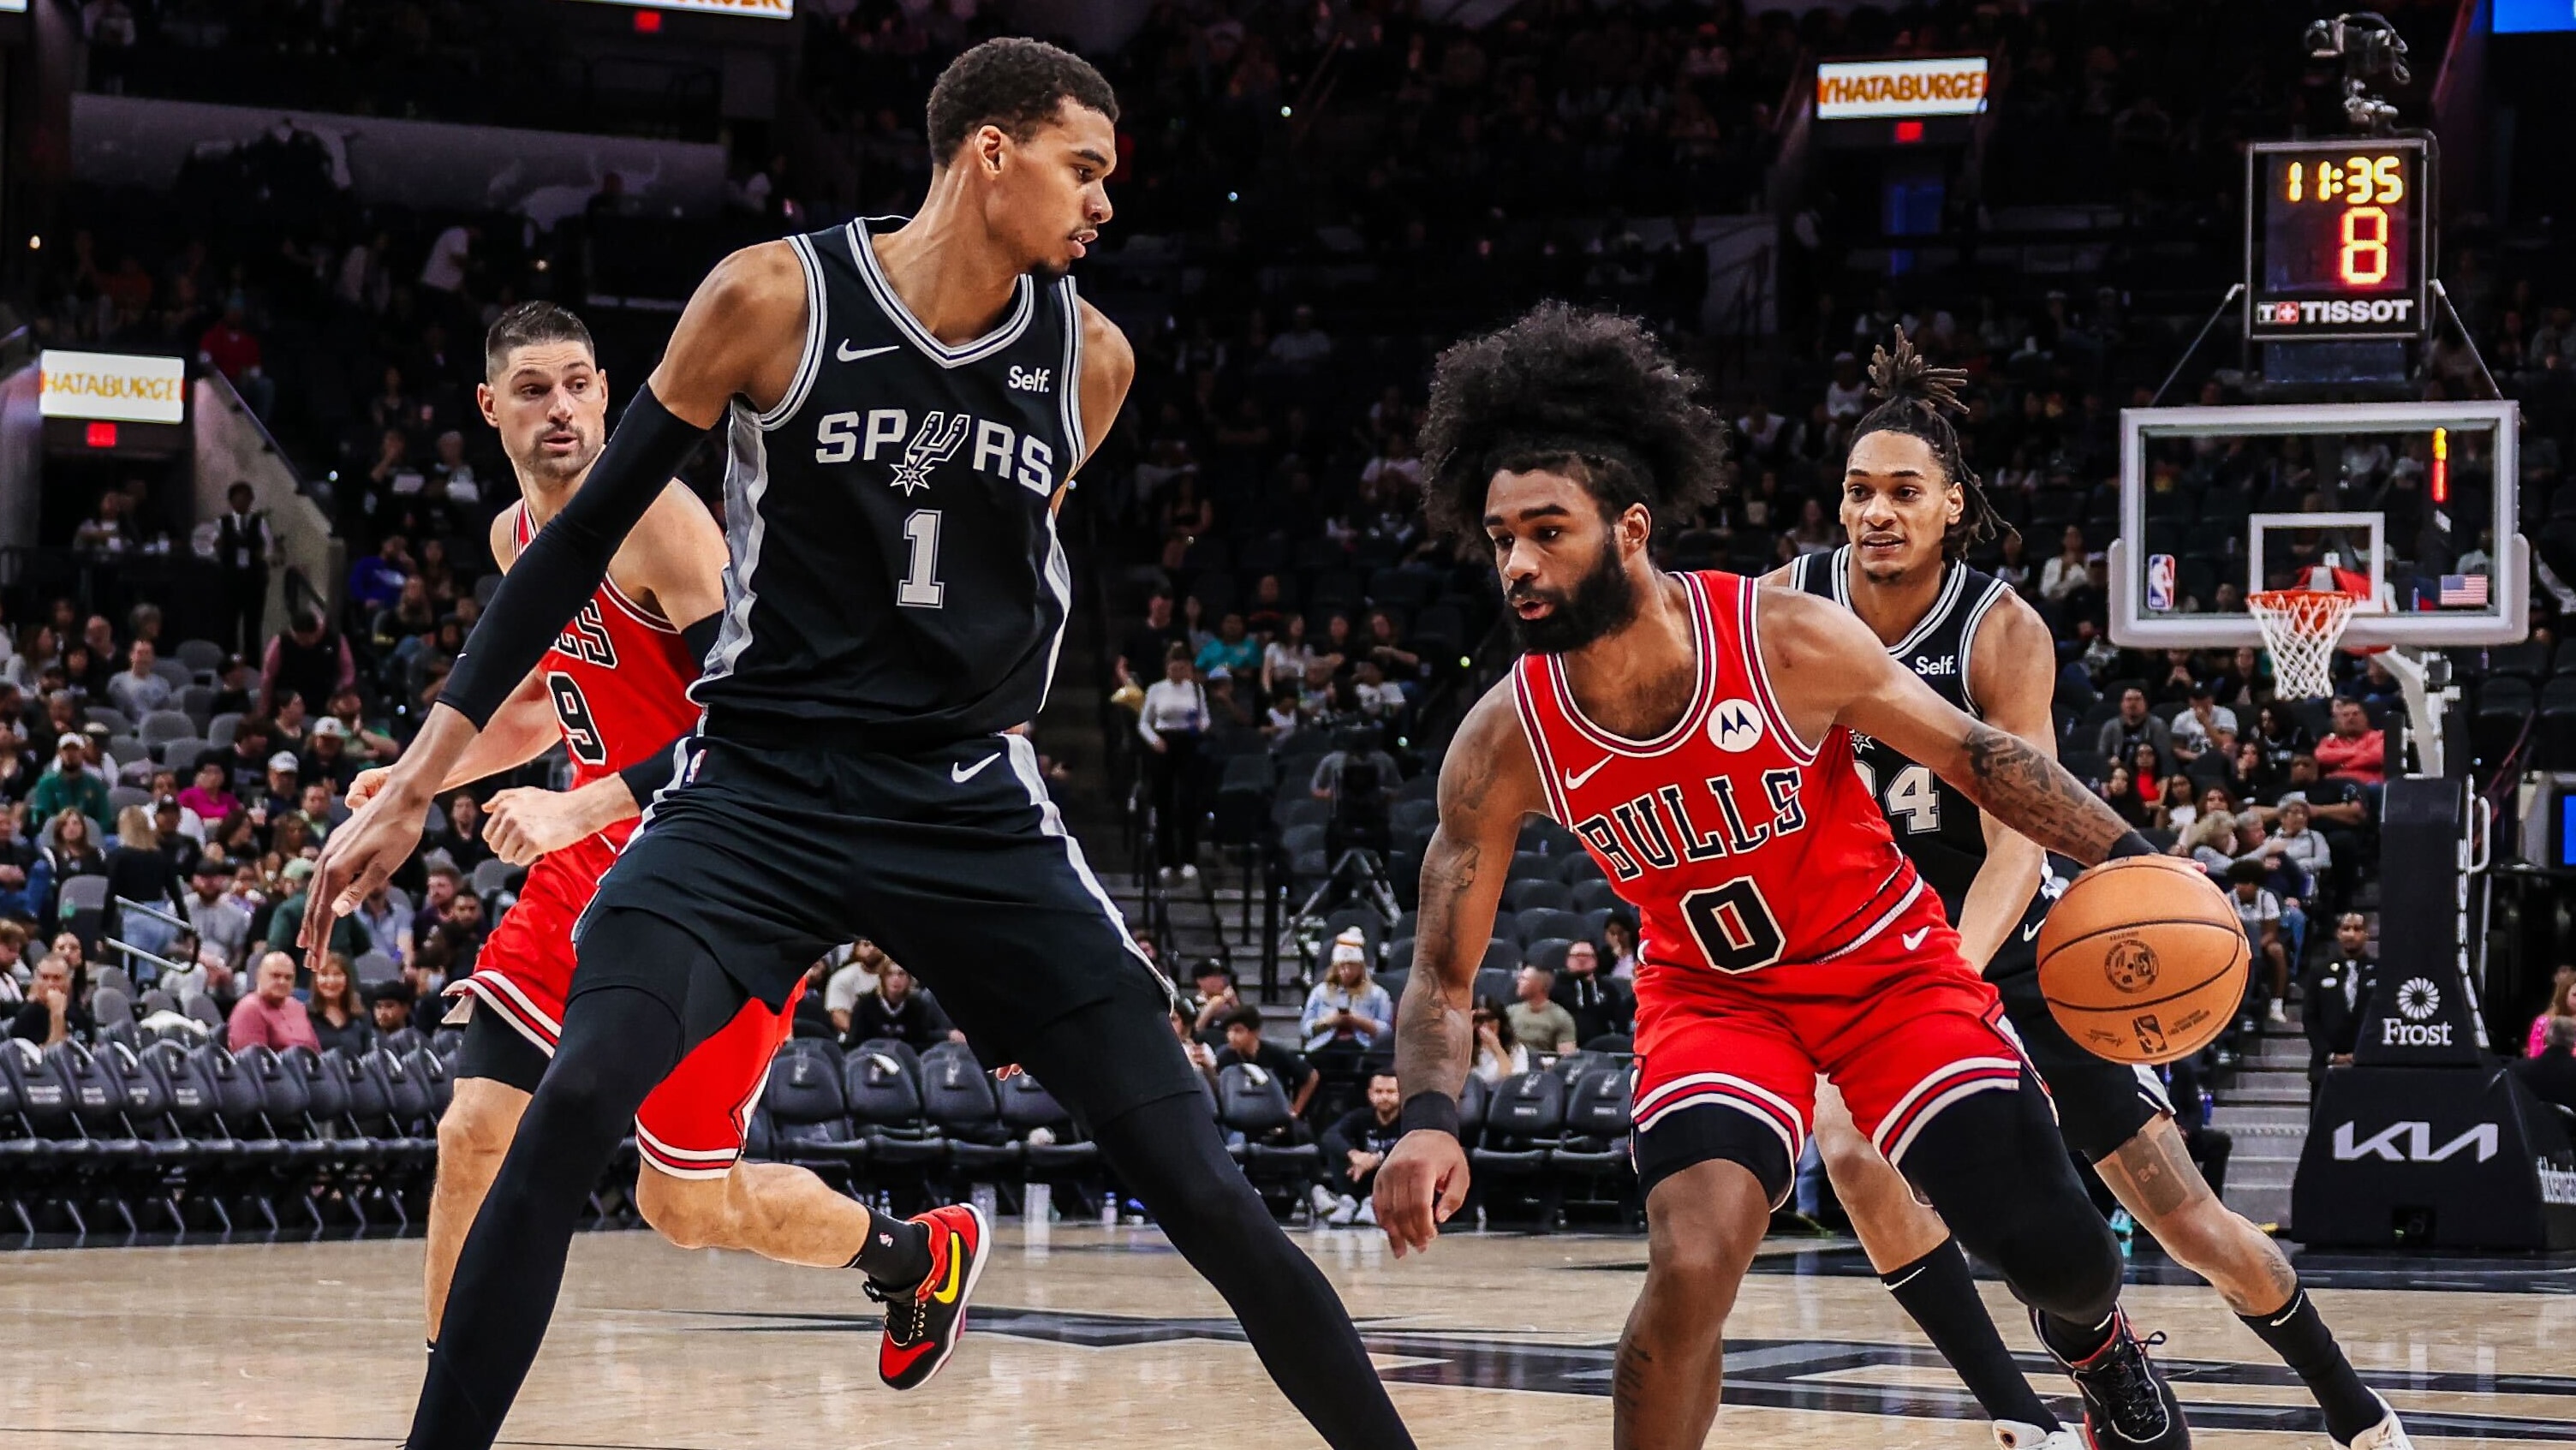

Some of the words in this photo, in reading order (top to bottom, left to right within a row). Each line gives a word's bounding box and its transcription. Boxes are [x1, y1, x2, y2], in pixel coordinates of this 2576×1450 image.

[1817, 70, 1989, 104] HATABURGE
[2288, 156, 2404, 205] 11:35
[2342, 206, 2388, 284] 8
[2300, 300, 2414, 324] TISSOT
[1008, 365, 1051, 393] Self.
[815, 409, 1053, 497] SPURS
[897, 509, 945, 609] 1
[1915, 655, 1957, 676] Self.
[546, 671, 607, 766] 9
[1573, 766, 1806, 882] BULLS
[1679, 875, 1786, 975] 0
[2382, 1017, 2453, 1047] Frost
